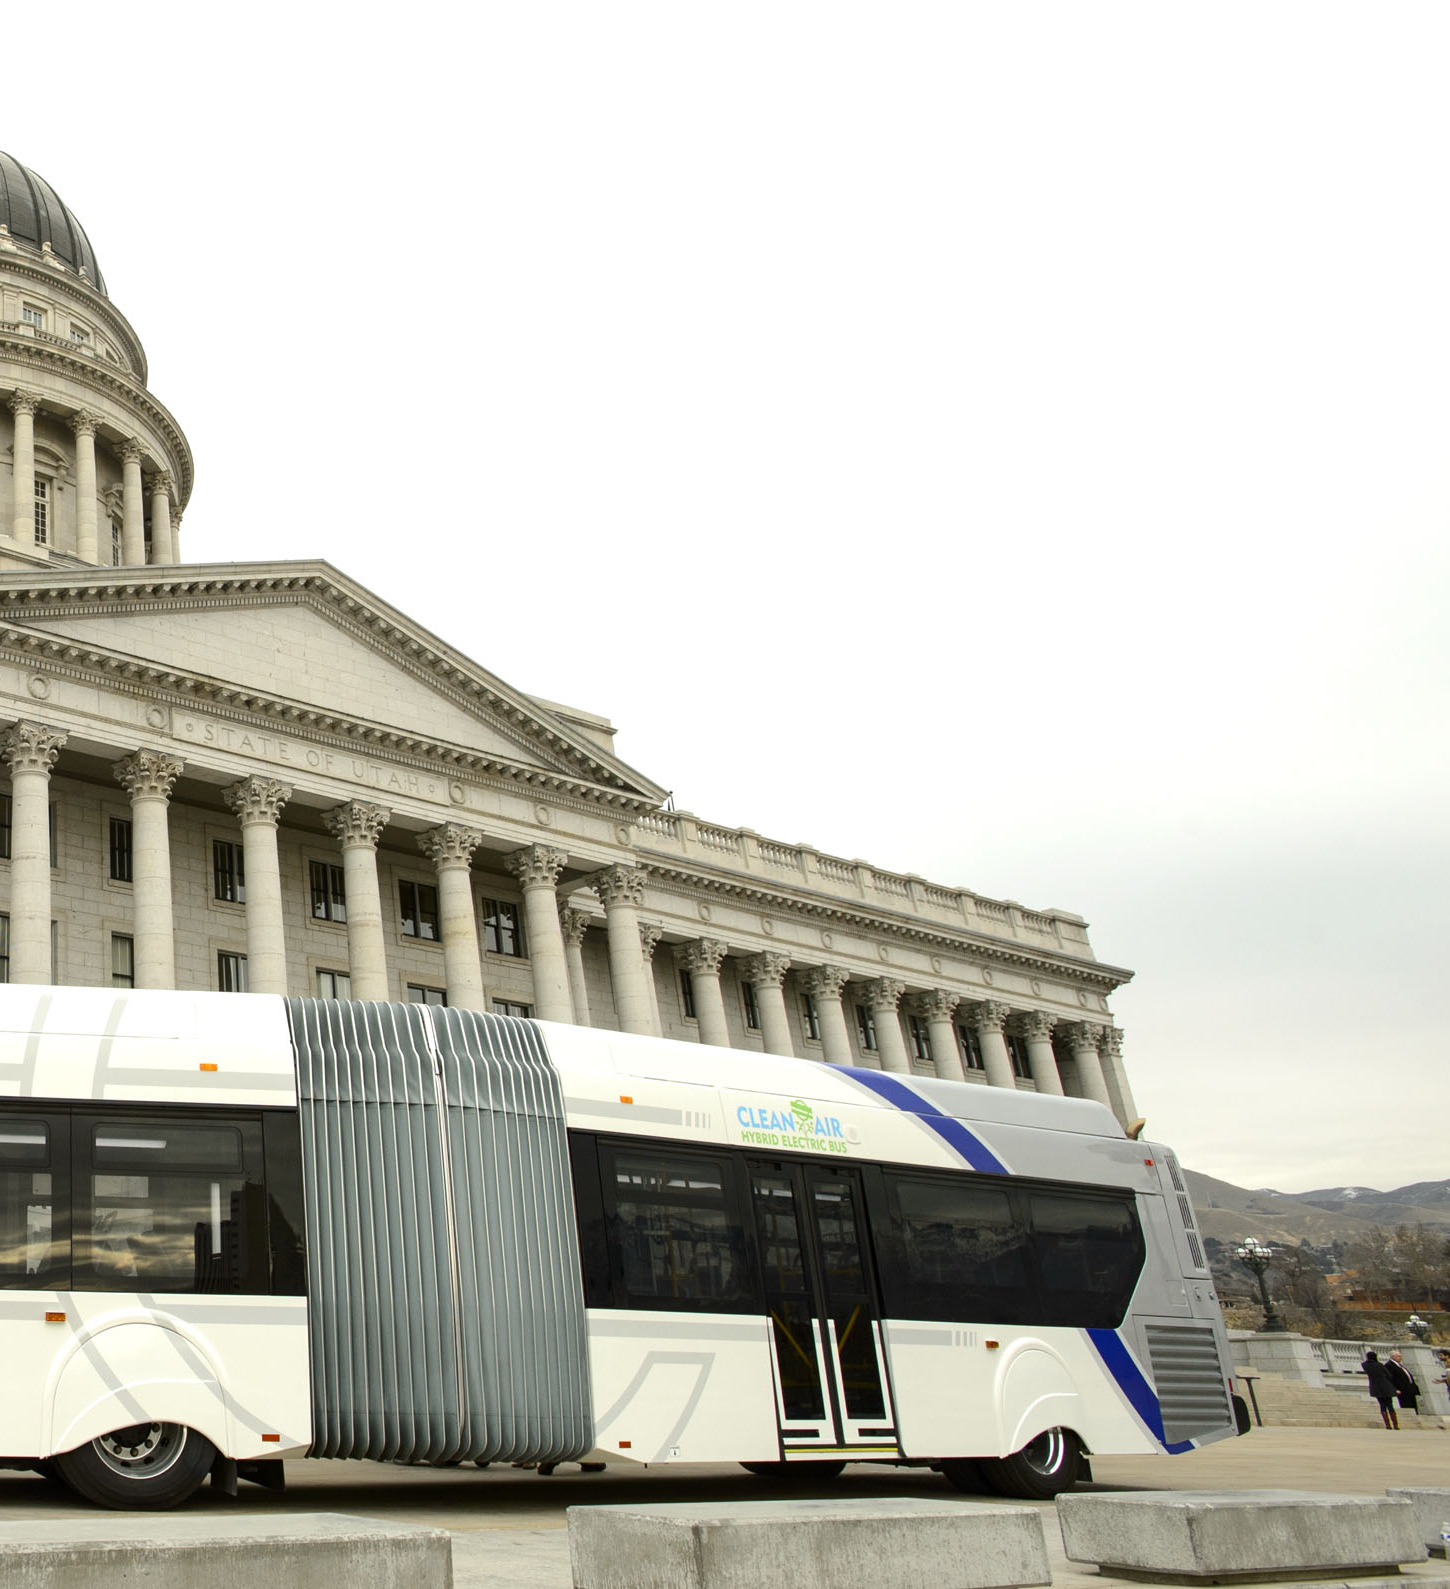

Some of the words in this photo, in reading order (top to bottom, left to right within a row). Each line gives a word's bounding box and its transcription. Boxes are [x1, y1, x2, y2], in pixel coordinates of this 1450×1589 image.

[203, 723, 292, 761] STATE
[306, 749, 336, 772] OF
[351, 760, 424, 793] UTAH
[737, 1105, 796, 1132] CLEAN
[814, 1116, 845, 1138] AIR
[741, 1131, 779, 1146] HYBRID
[781, 1135, 827, 1152] ELECTRIC
[828, 1140, 848, 1154] BUS
